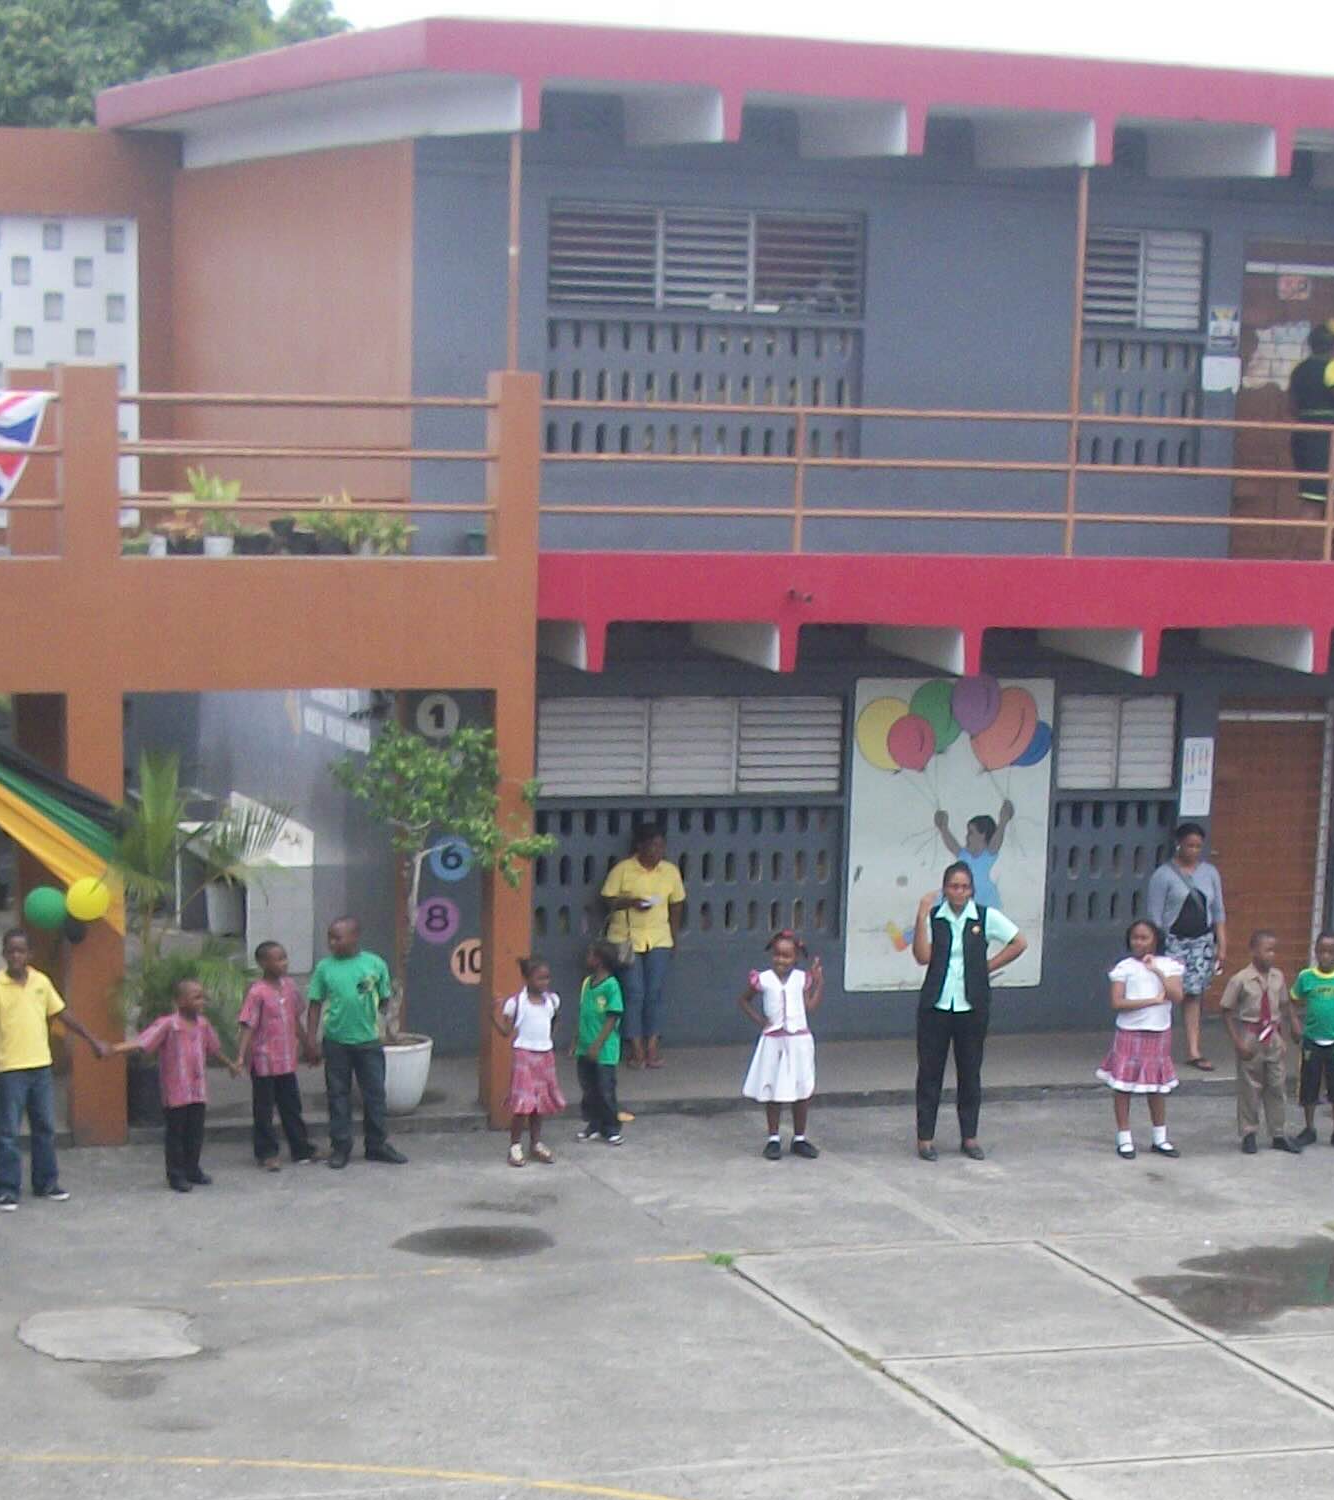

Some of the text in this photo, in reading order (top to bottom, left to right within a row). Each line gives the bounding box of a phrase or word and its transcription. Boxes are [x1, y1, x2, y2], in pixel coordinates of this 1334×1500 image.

[428, 703, 445, 729] 1
[441, 842, 463, 870] 6
[425, 904, 449, 933] 8
